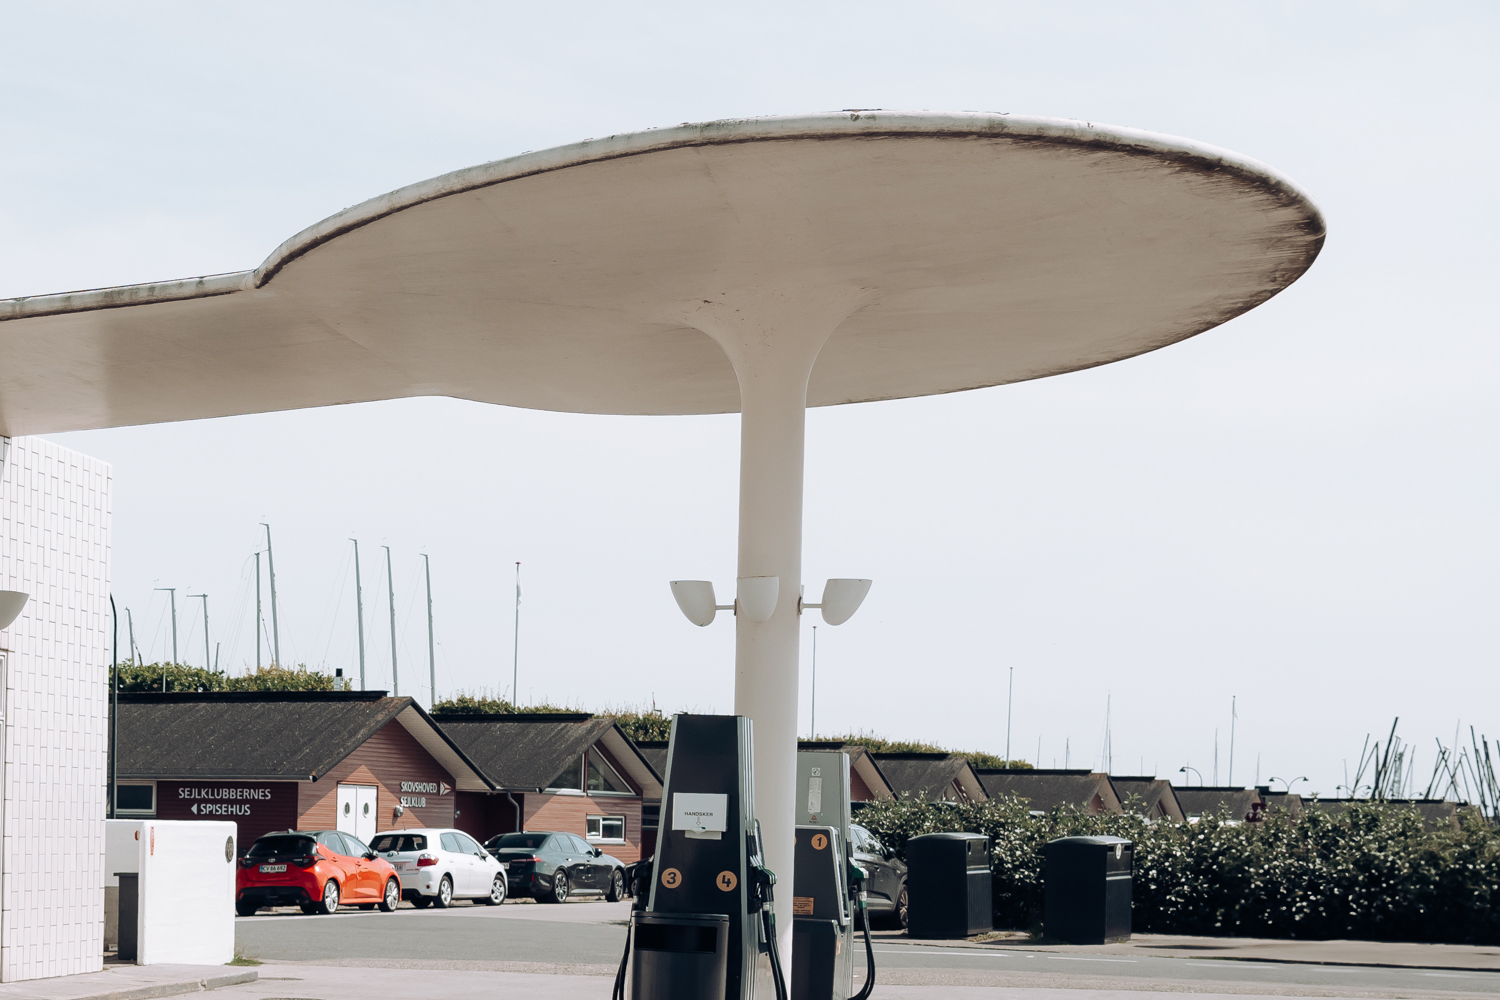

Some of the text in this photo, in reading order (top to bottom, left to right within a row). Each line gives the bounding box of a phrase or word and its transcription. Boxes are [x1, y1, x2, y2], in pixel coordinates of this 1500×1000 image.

[401, 781, 438, 793] SKOVSHOVED
[178, 788, 272, 800] SEJLKLUBBERNES
[400, 796, 426, 808] SEJLKLUB
[200, 803, 251, 815] SPISEHUS
[816, 836, 823, 847] 1
[666, 871, 677, 885] 3
[721, 874, 732, 888] 4
